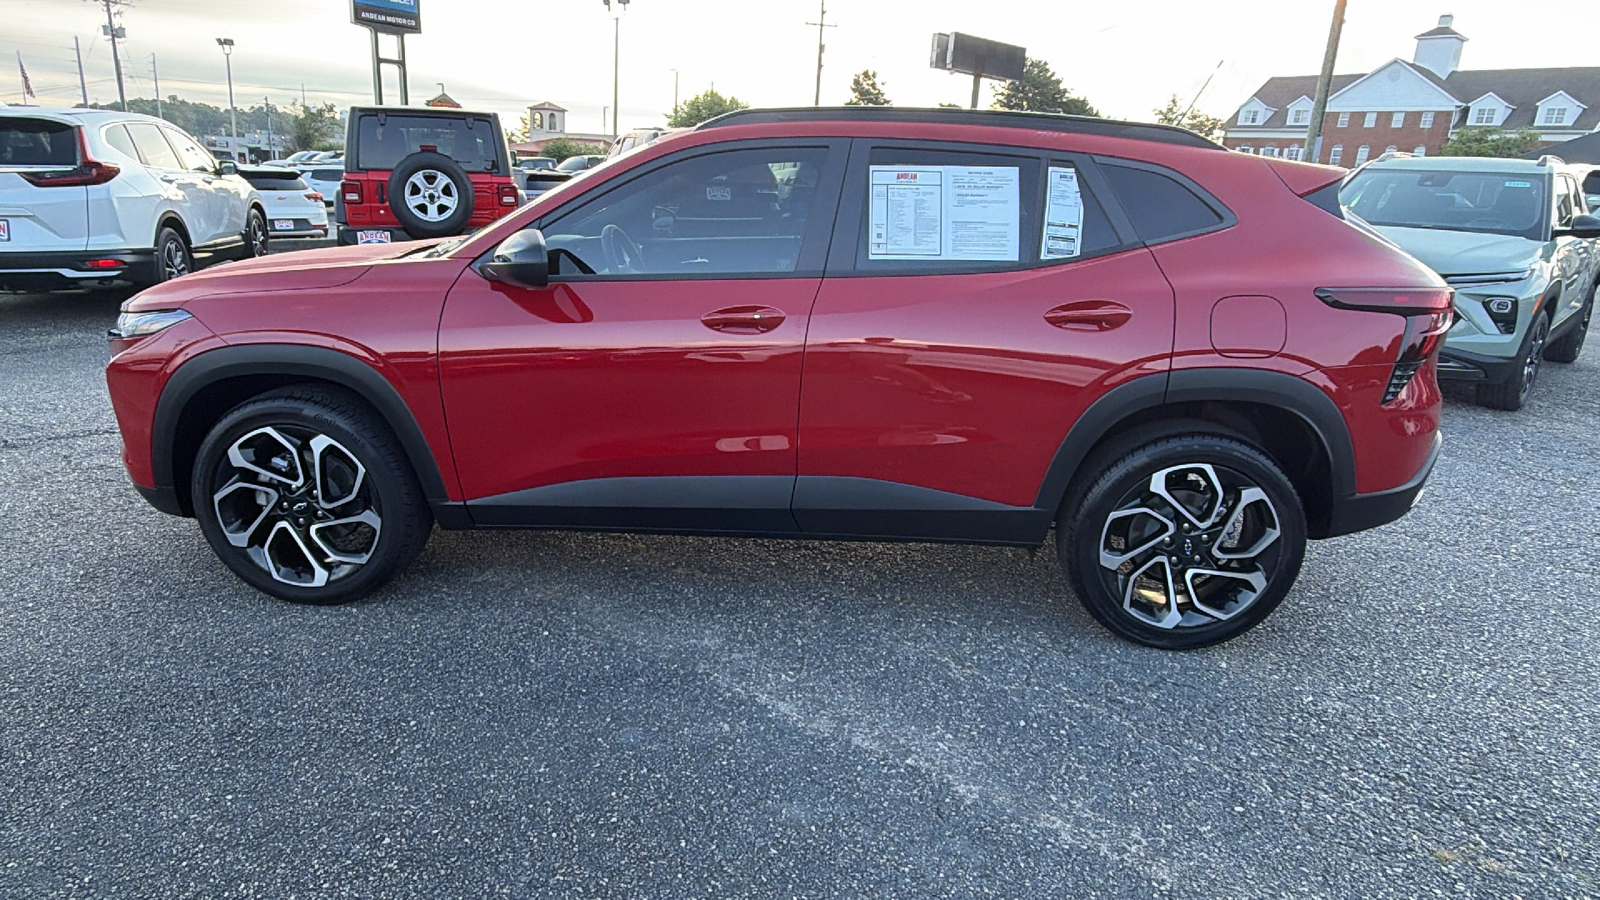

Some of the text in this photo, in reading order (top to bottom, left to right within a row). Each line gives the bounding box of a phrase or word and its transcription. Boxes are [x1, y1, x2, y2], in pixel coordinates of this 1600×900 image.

[361, 11, 386, 21] ANDEAN
[386, 16, 407, 25] MOTOR
[896, 172, 918, 180] ANDEAN
[360, 232, 389, 241] ANDEAN
